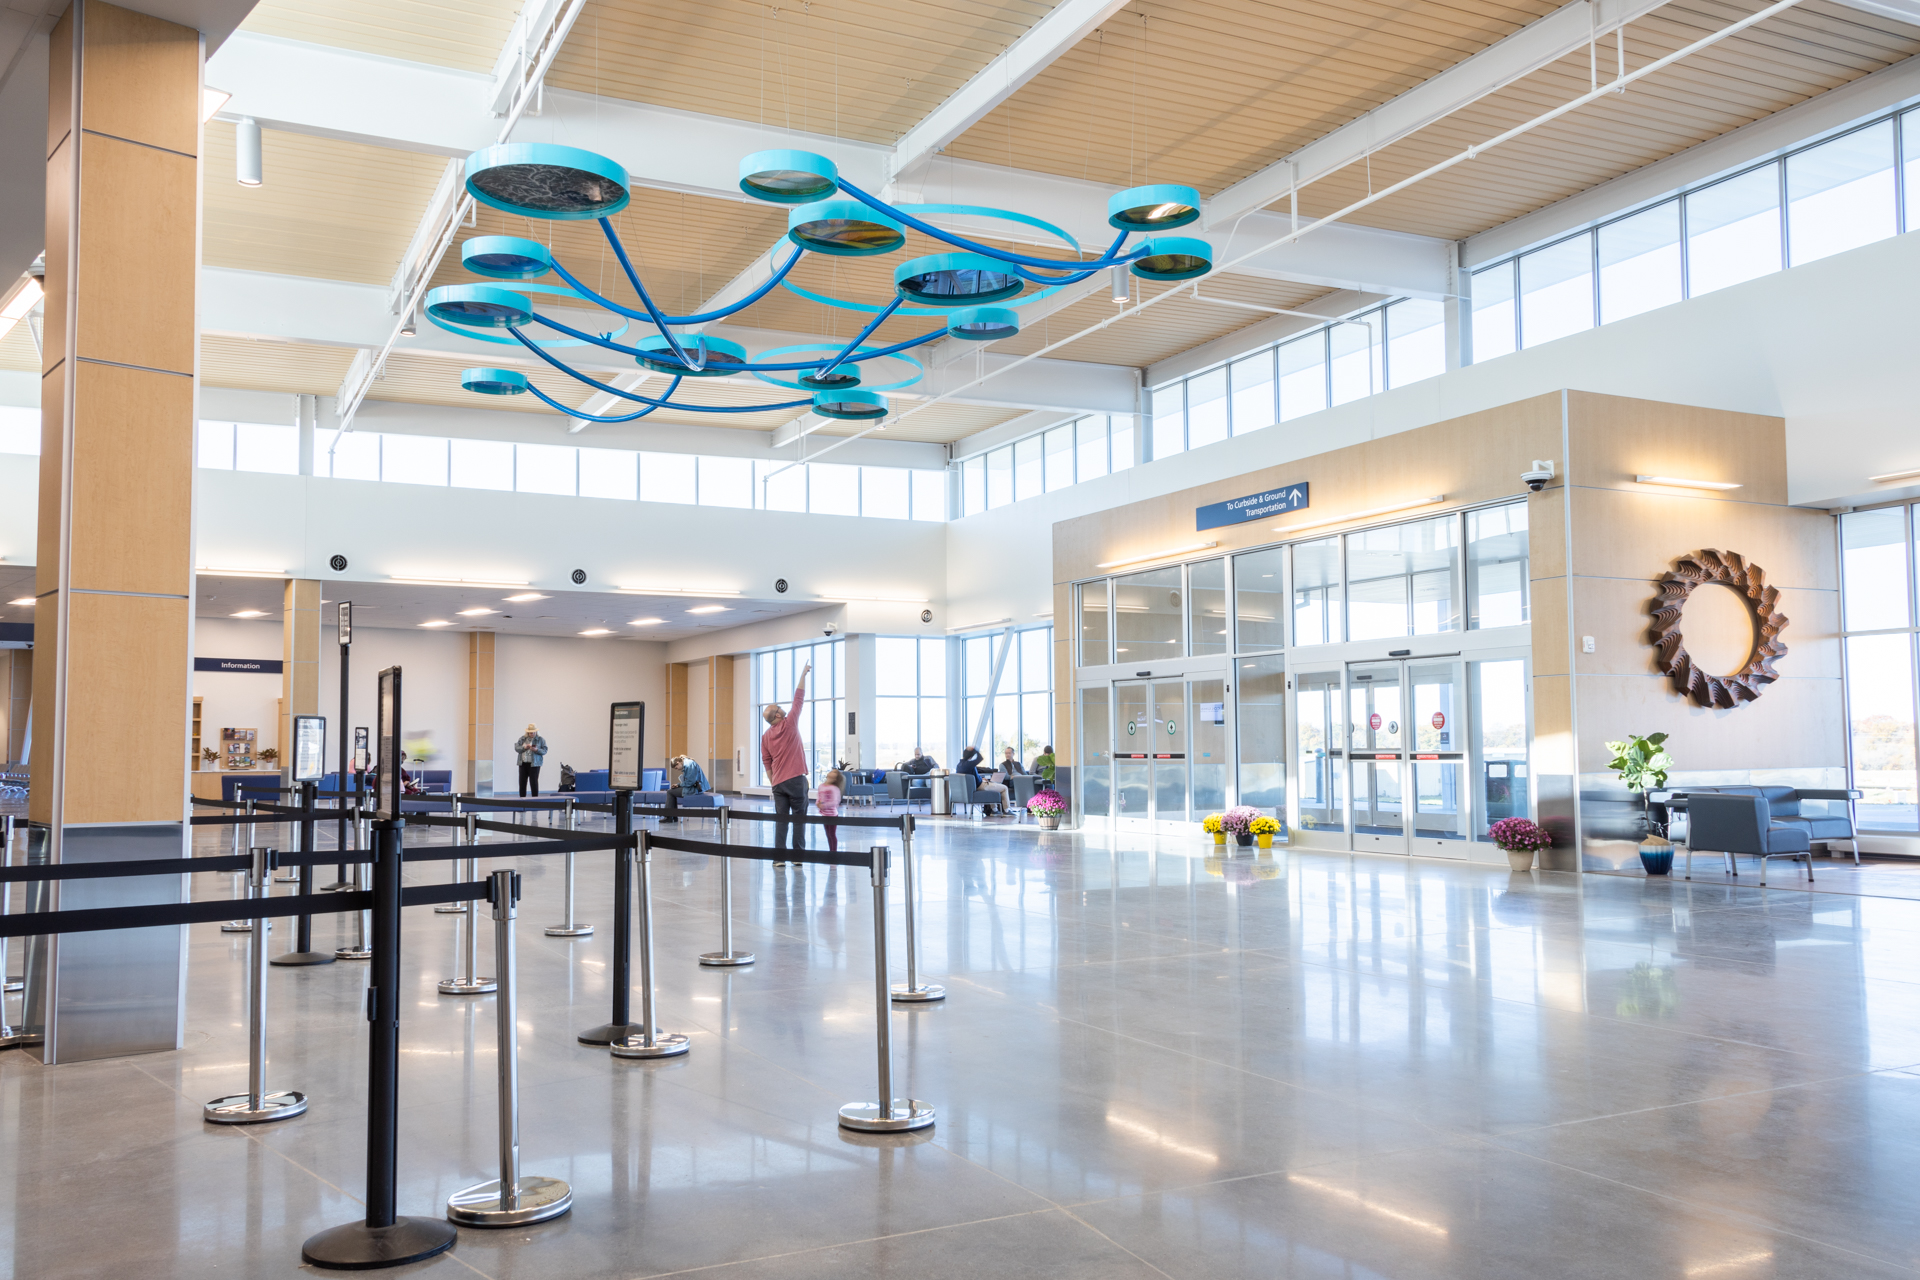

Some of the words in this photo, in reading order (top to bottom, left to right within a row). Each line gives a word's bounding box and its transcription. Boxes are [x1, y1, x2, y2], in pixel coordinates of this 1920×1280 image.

[1234, 497, 1258, 509] Curbside
[1264, 490, 1286, 502] Ground
[1246, 502, 1286, 516] Transportation
